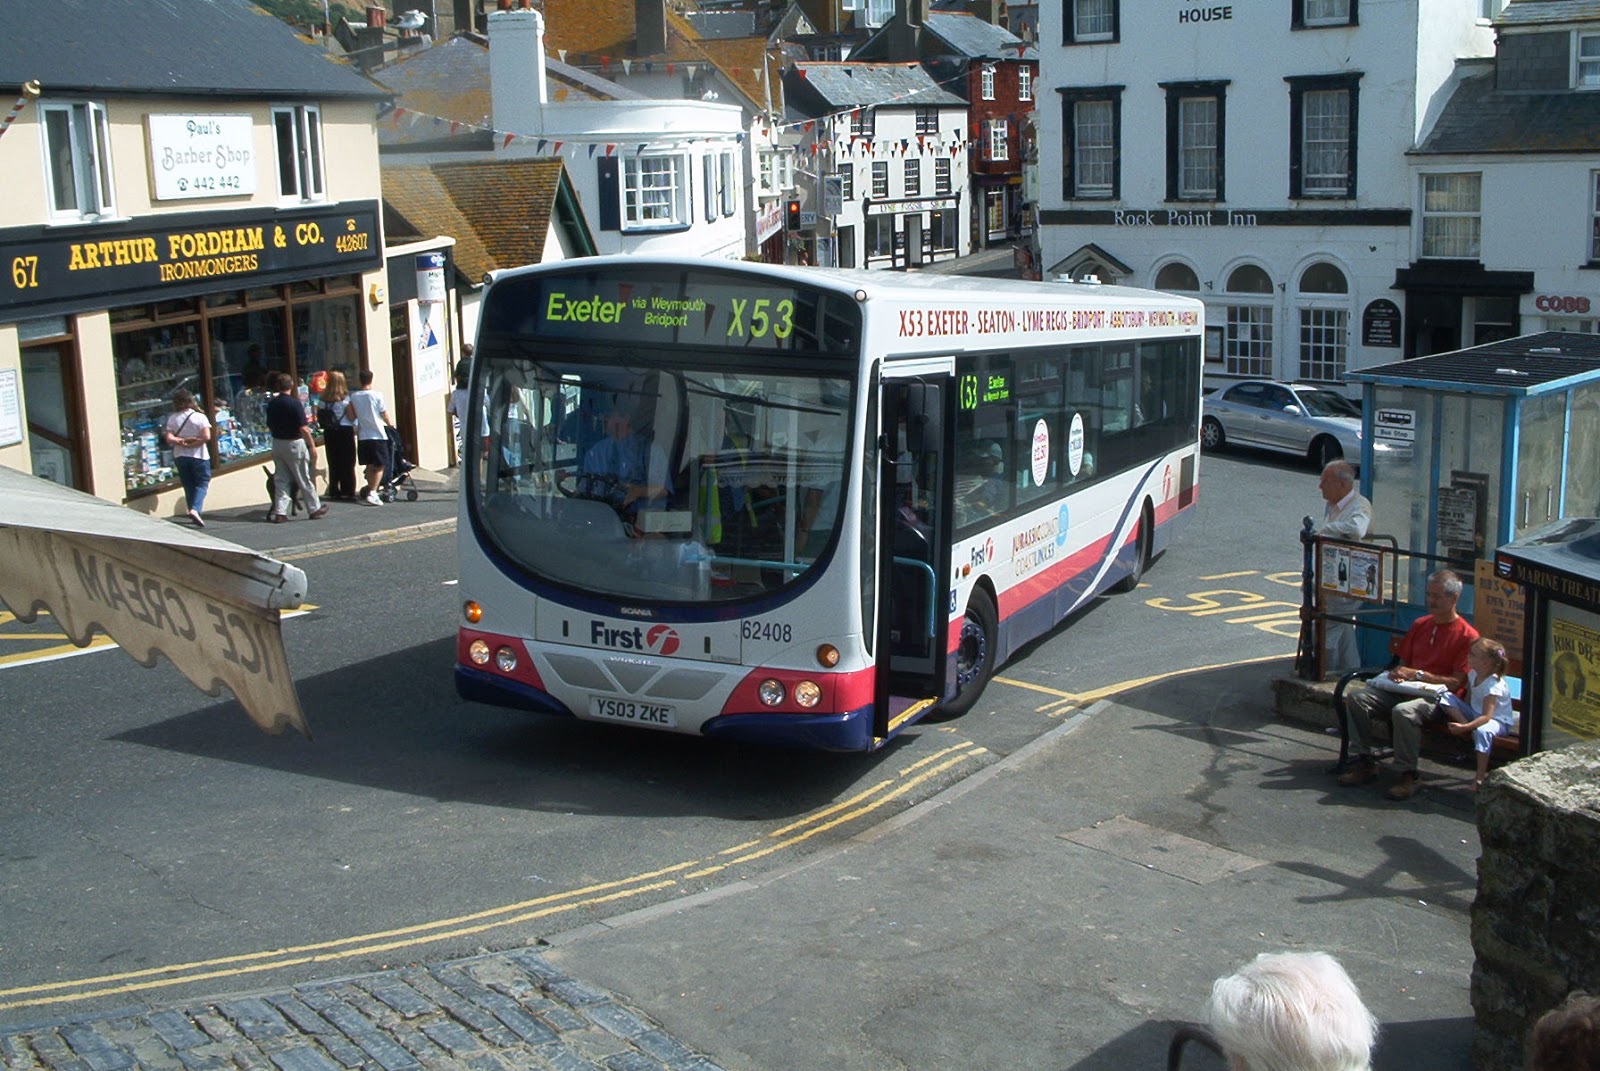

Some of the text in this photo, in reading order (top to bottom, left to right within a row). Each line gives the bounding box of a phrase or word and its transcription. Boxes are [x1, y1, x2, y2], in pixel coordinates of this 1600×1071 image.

[1179, 6, 1232, 23] HOUSE
[186, 120, 221, 137] Paul's
[162, 144, 250, 171] Barber Shop
[194, 175, 240, 190] 442 442
[1114, 209, 1258, 227] Rock Point Inn
[69, 222, 325, 271] ARTHUR FORDHAM & CO.
[12, 256, 39, 289] 67
[159, 256, 258, 282] IRONMONGERS
[546, 292, 794, 339] Exeter via Weymouth X53
[1535, 295, 1591, 313] COBB
[644, 312, 688, 327] Bridport
[899, 310, 924, 337] X53
[927, 310, 969, 336] EXETER
[977, 310, 1015, 334] SEATON
[1023, 310, 1044, 332] LYME
[1045, 310, 1068, 331] REGIS
[970, 545, 985, 569] First
[1516, 564, 1559, 591] MARINE
[590, 620, 792, 650] First 62408
[596, 700, 669, 724] YS03 ZKE
